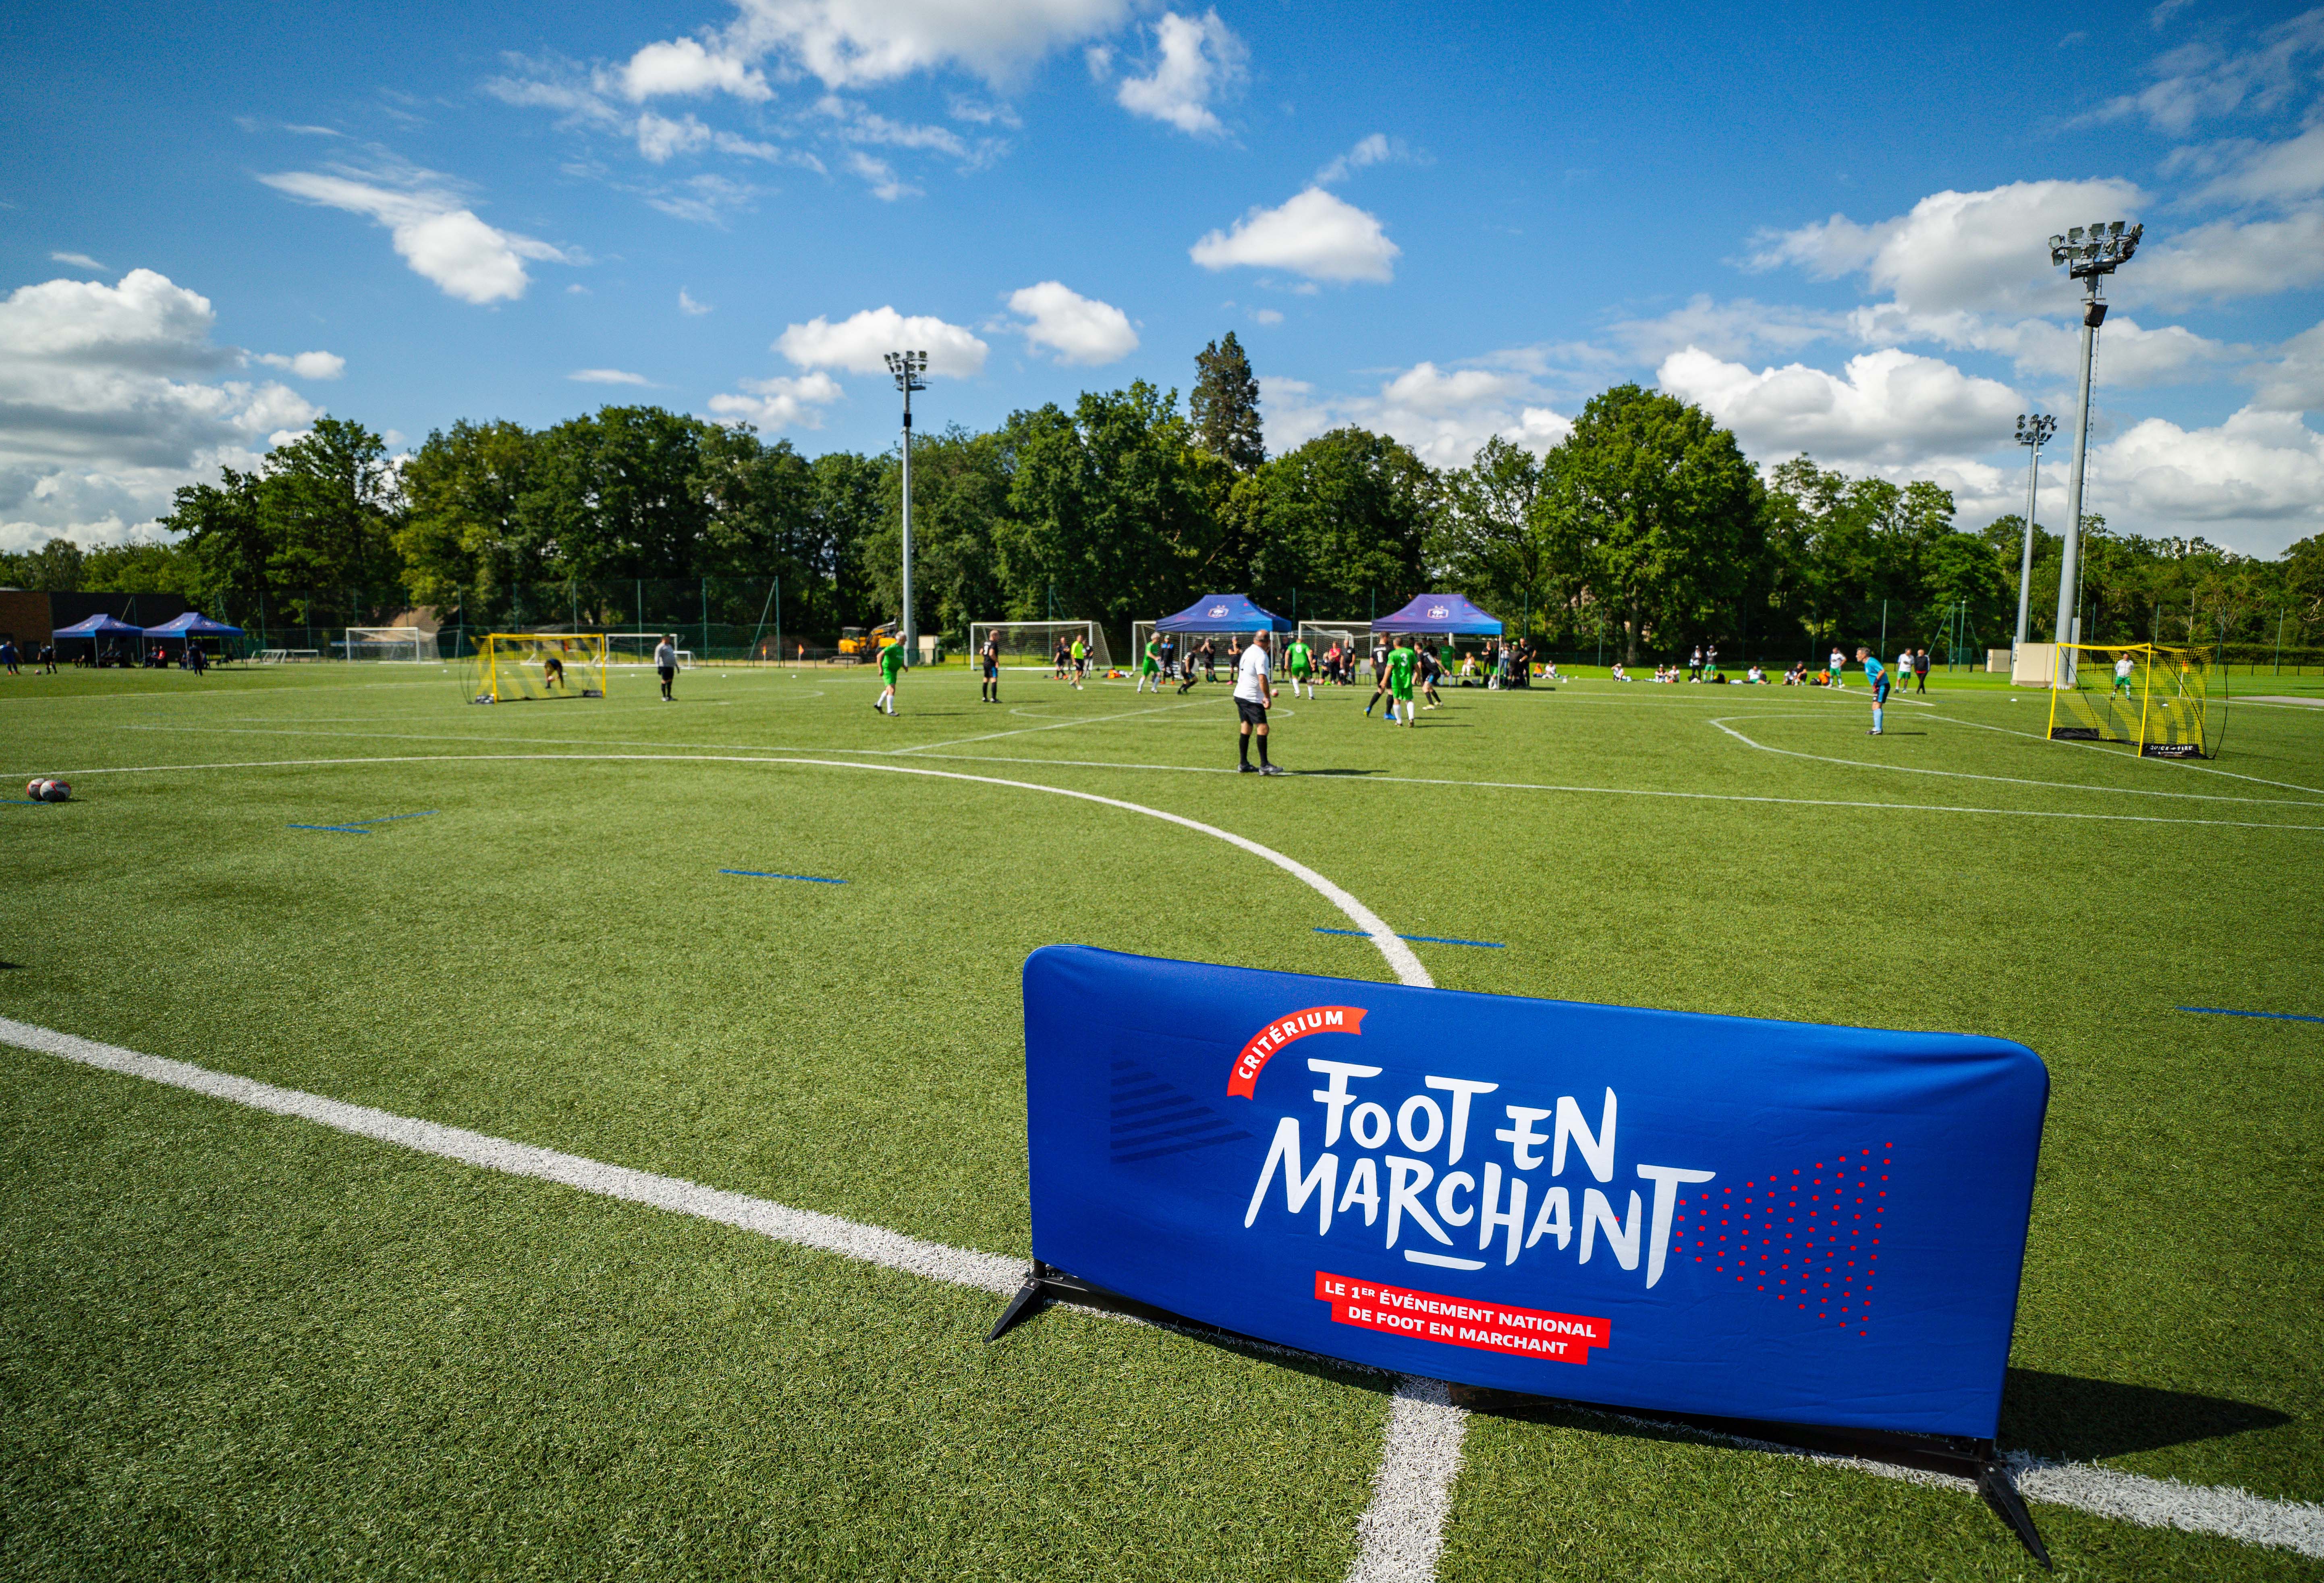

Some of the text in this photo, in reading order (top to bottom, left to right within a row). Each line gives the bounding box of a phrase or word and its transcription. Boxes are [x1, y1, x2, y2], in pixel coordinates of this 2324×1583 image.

[1400, 653, 1407, 666] 3
[1239, 1011, 1343, 1079] CRITÉRIUM
[1307, 1058, 1617, 1183] FOOT EN
[1244, 1117, 1716, 1289] MARCHANT
[1325, 1281, 1596, 1338] LE 1ER ÉVÉNEMENT NATIONAL
[1349, 1306, 1568, 1354] DE FOOT EN MARCHANT
